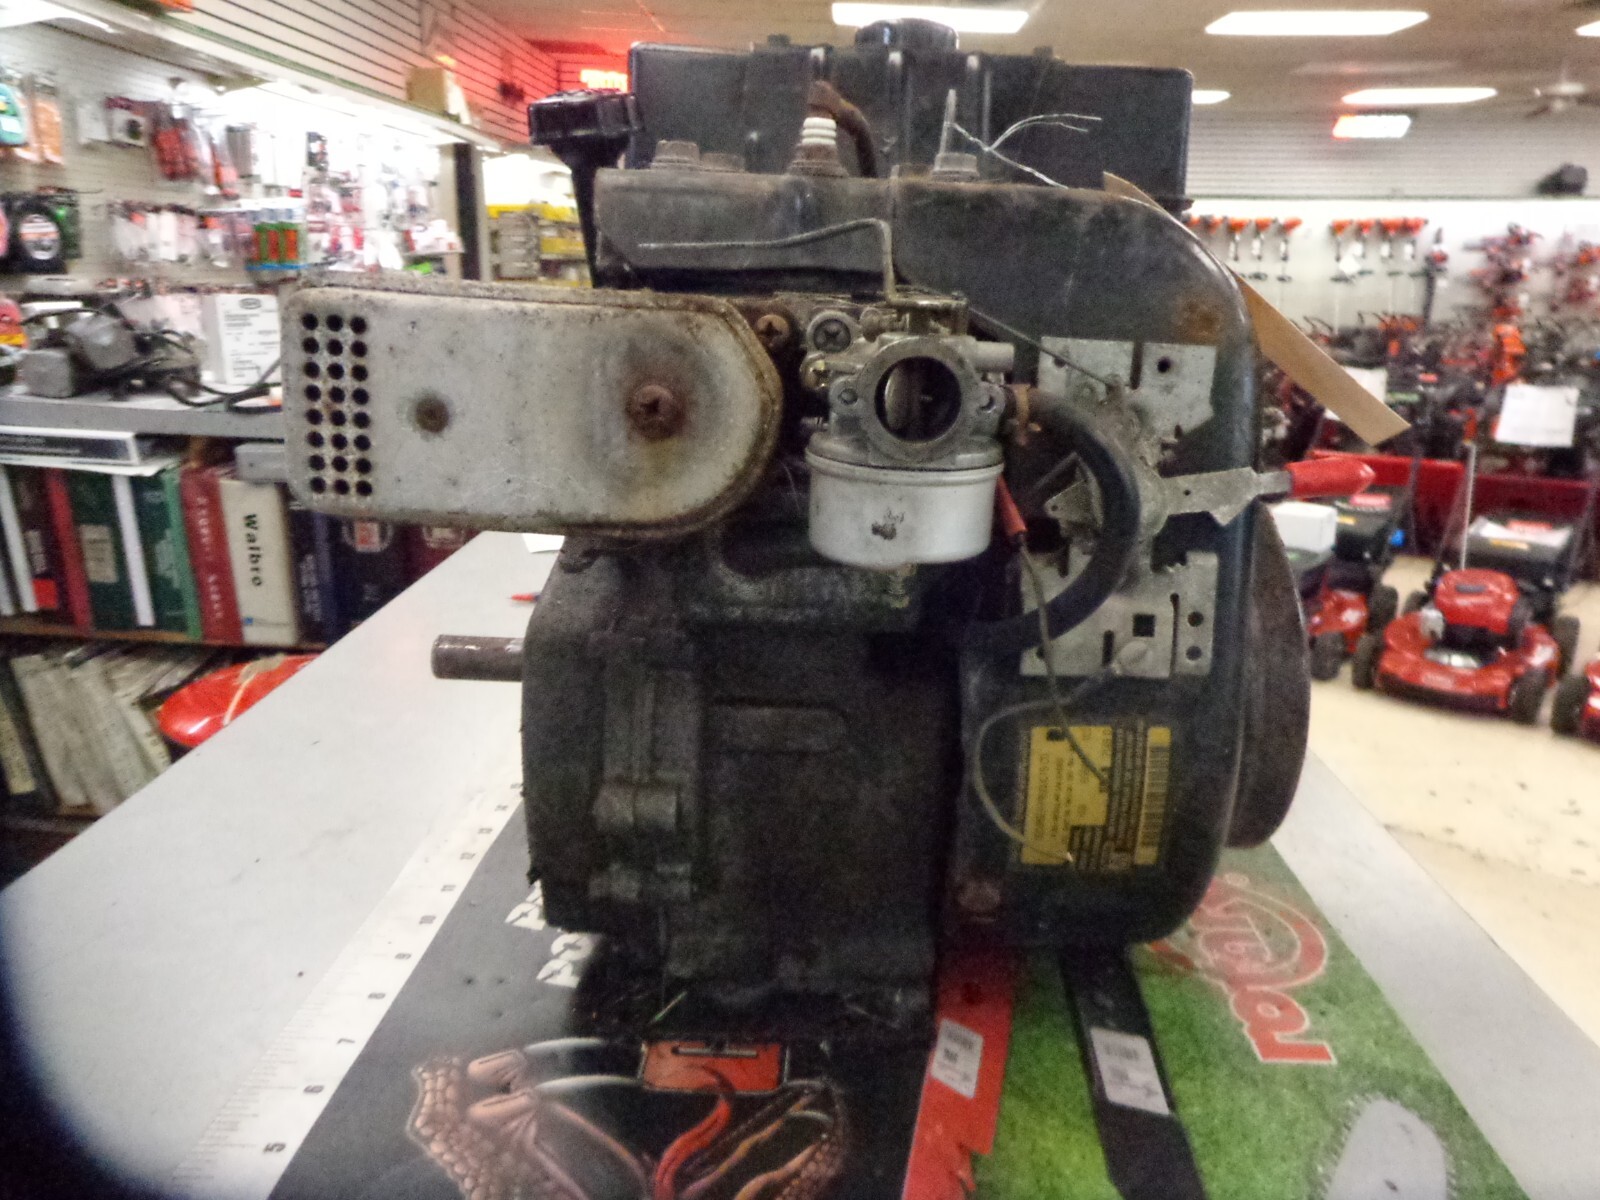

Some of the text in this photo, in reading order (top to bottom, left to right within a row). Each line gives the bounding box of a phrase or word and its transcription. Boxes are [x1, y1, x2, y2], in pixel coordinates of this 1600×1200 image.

[243, 513, 263, 587] Walbro
[368, 992, 387, 1000] 8
[337, 1037, 356, 1045] 7
[303, 1085, 325, 1094] 6
[263, 1142, 287, 1154] 5
